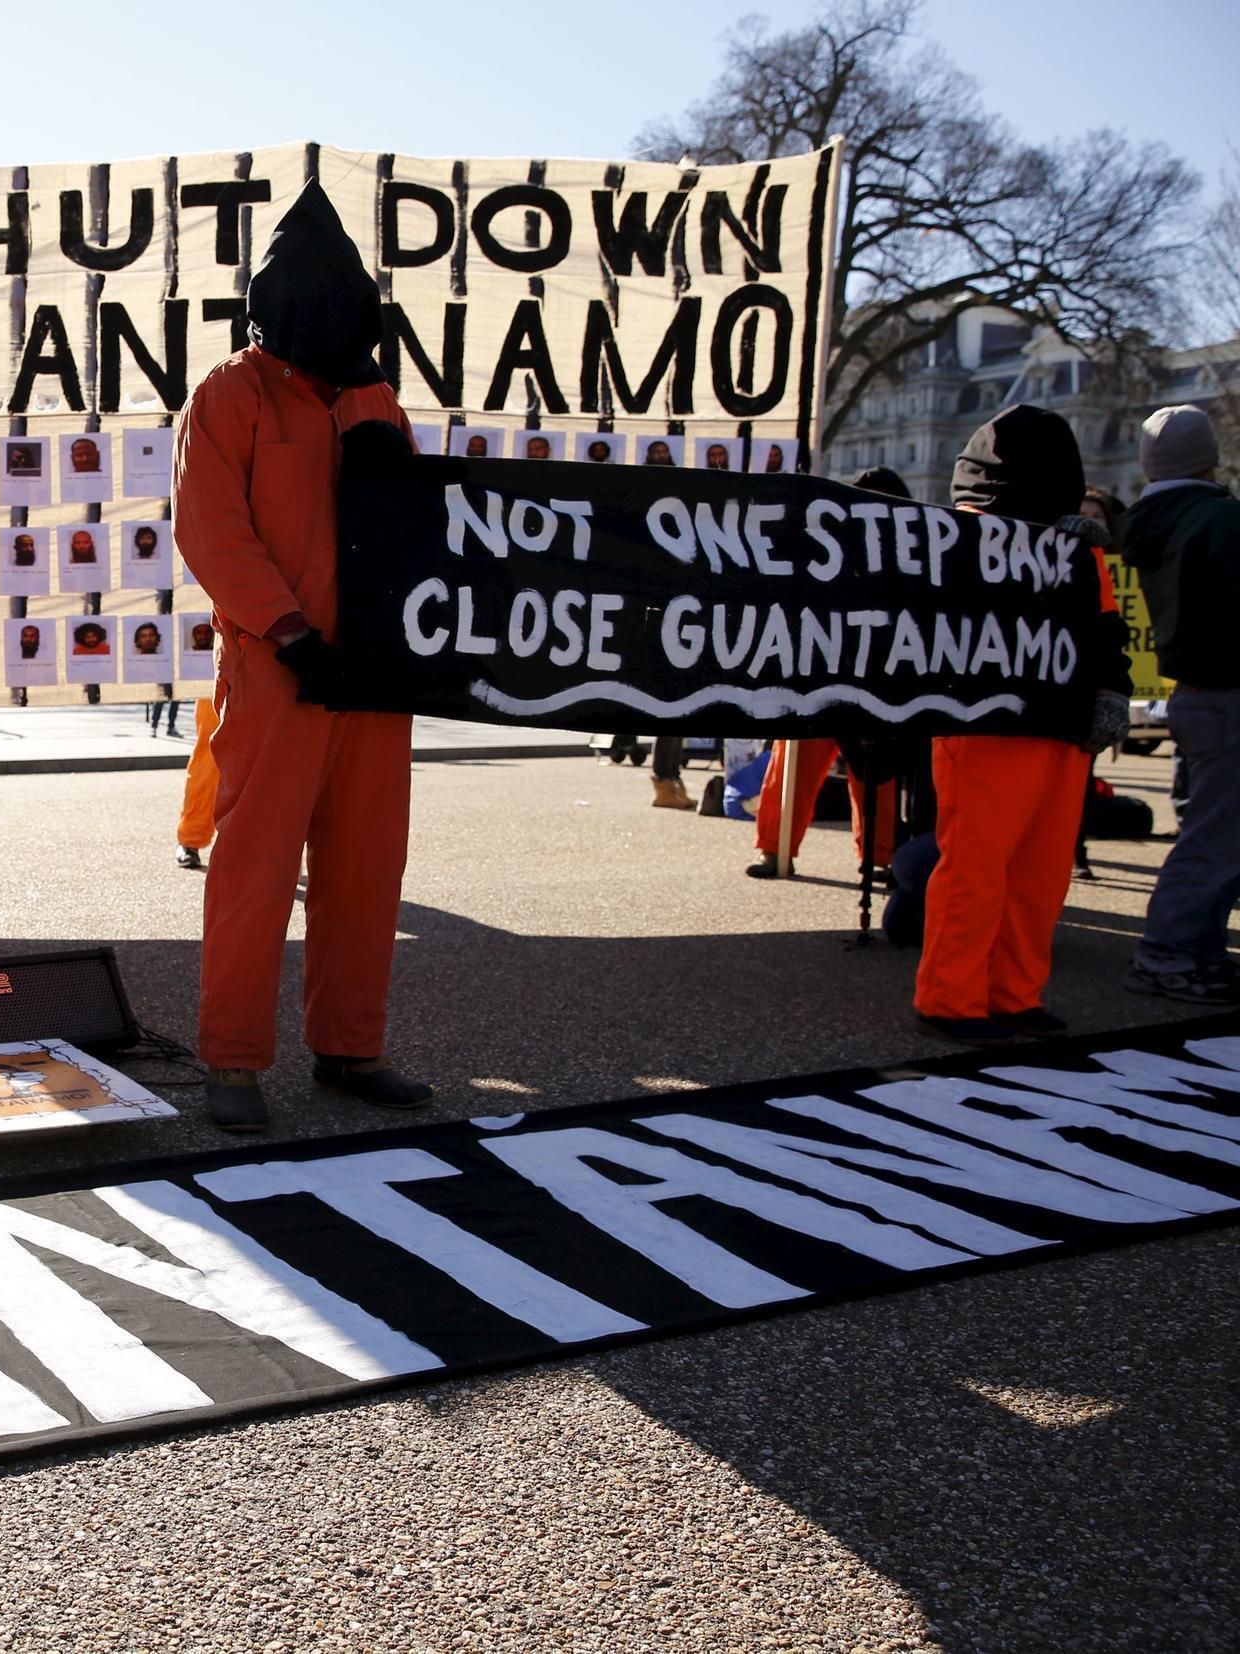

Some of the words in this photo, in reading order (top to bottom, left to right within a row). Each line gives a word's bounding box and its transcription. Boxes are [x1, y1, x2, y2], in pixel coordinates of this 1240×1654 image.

[381, 182, 788, 276] DOWN
[445, 484, 593, 560] NOT
[646, 496, 793, 575] ONE
[805, 499, 960, 585] STEP
[979, 515, 1077, 592] BACK
[403, 577, 624, 671] CLOSE
[660, 594, 1076, 684] GUANTANAMO
